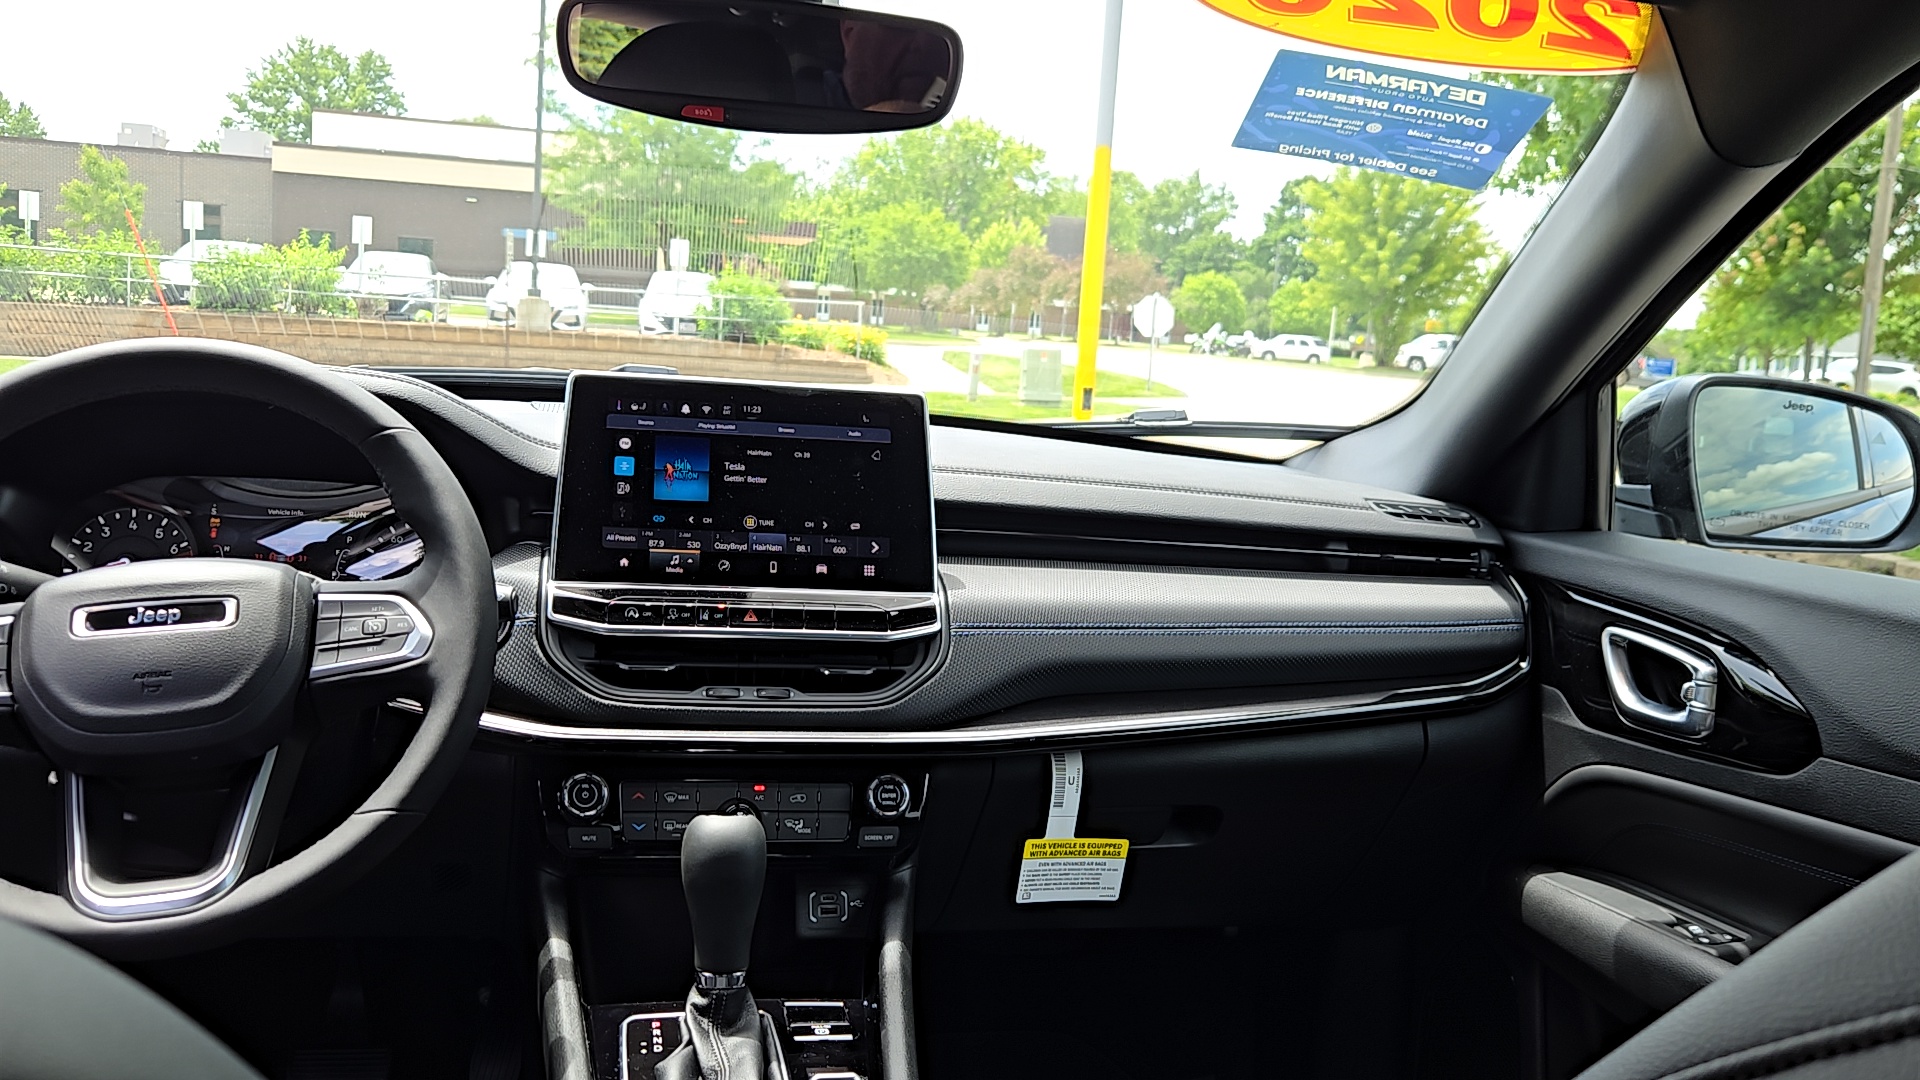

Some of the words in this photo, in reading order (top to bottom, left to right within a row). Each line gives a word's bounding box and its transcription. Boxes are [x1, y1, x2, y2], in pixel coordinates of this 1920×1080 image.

[743, 405, 761, 413] 11:23
[1783, 400, 1814, 413] Jeep
[724, 462, 745, 471] Tesla
[747, 476, 767, 484] Better
[268, 508, 290, 516] Vehicle
[1730, 509, 1765, 519] OBJECTS
[1817, 518, 1833, 526] ARE
[1839, 520, 1870, 530] CLOSER
[129, 520, 138, 530] 4
[101, 526, 111, 537] 3
[155, 528, 164, 538] 5
[1809, 527, 1843, 536] APPEAR
[391, 535, 404, 543] 60
[615, 534, 636, 542] Presets
[83, 541, 93, 552] 2
[170, 544, 178, 554] 6
[753, 544, 782, 552] HairNatn
[796, 545, 811, 553] 88.1
[833, 546, 847, 554] 600
[128, 606, 181, 624] Jeep
